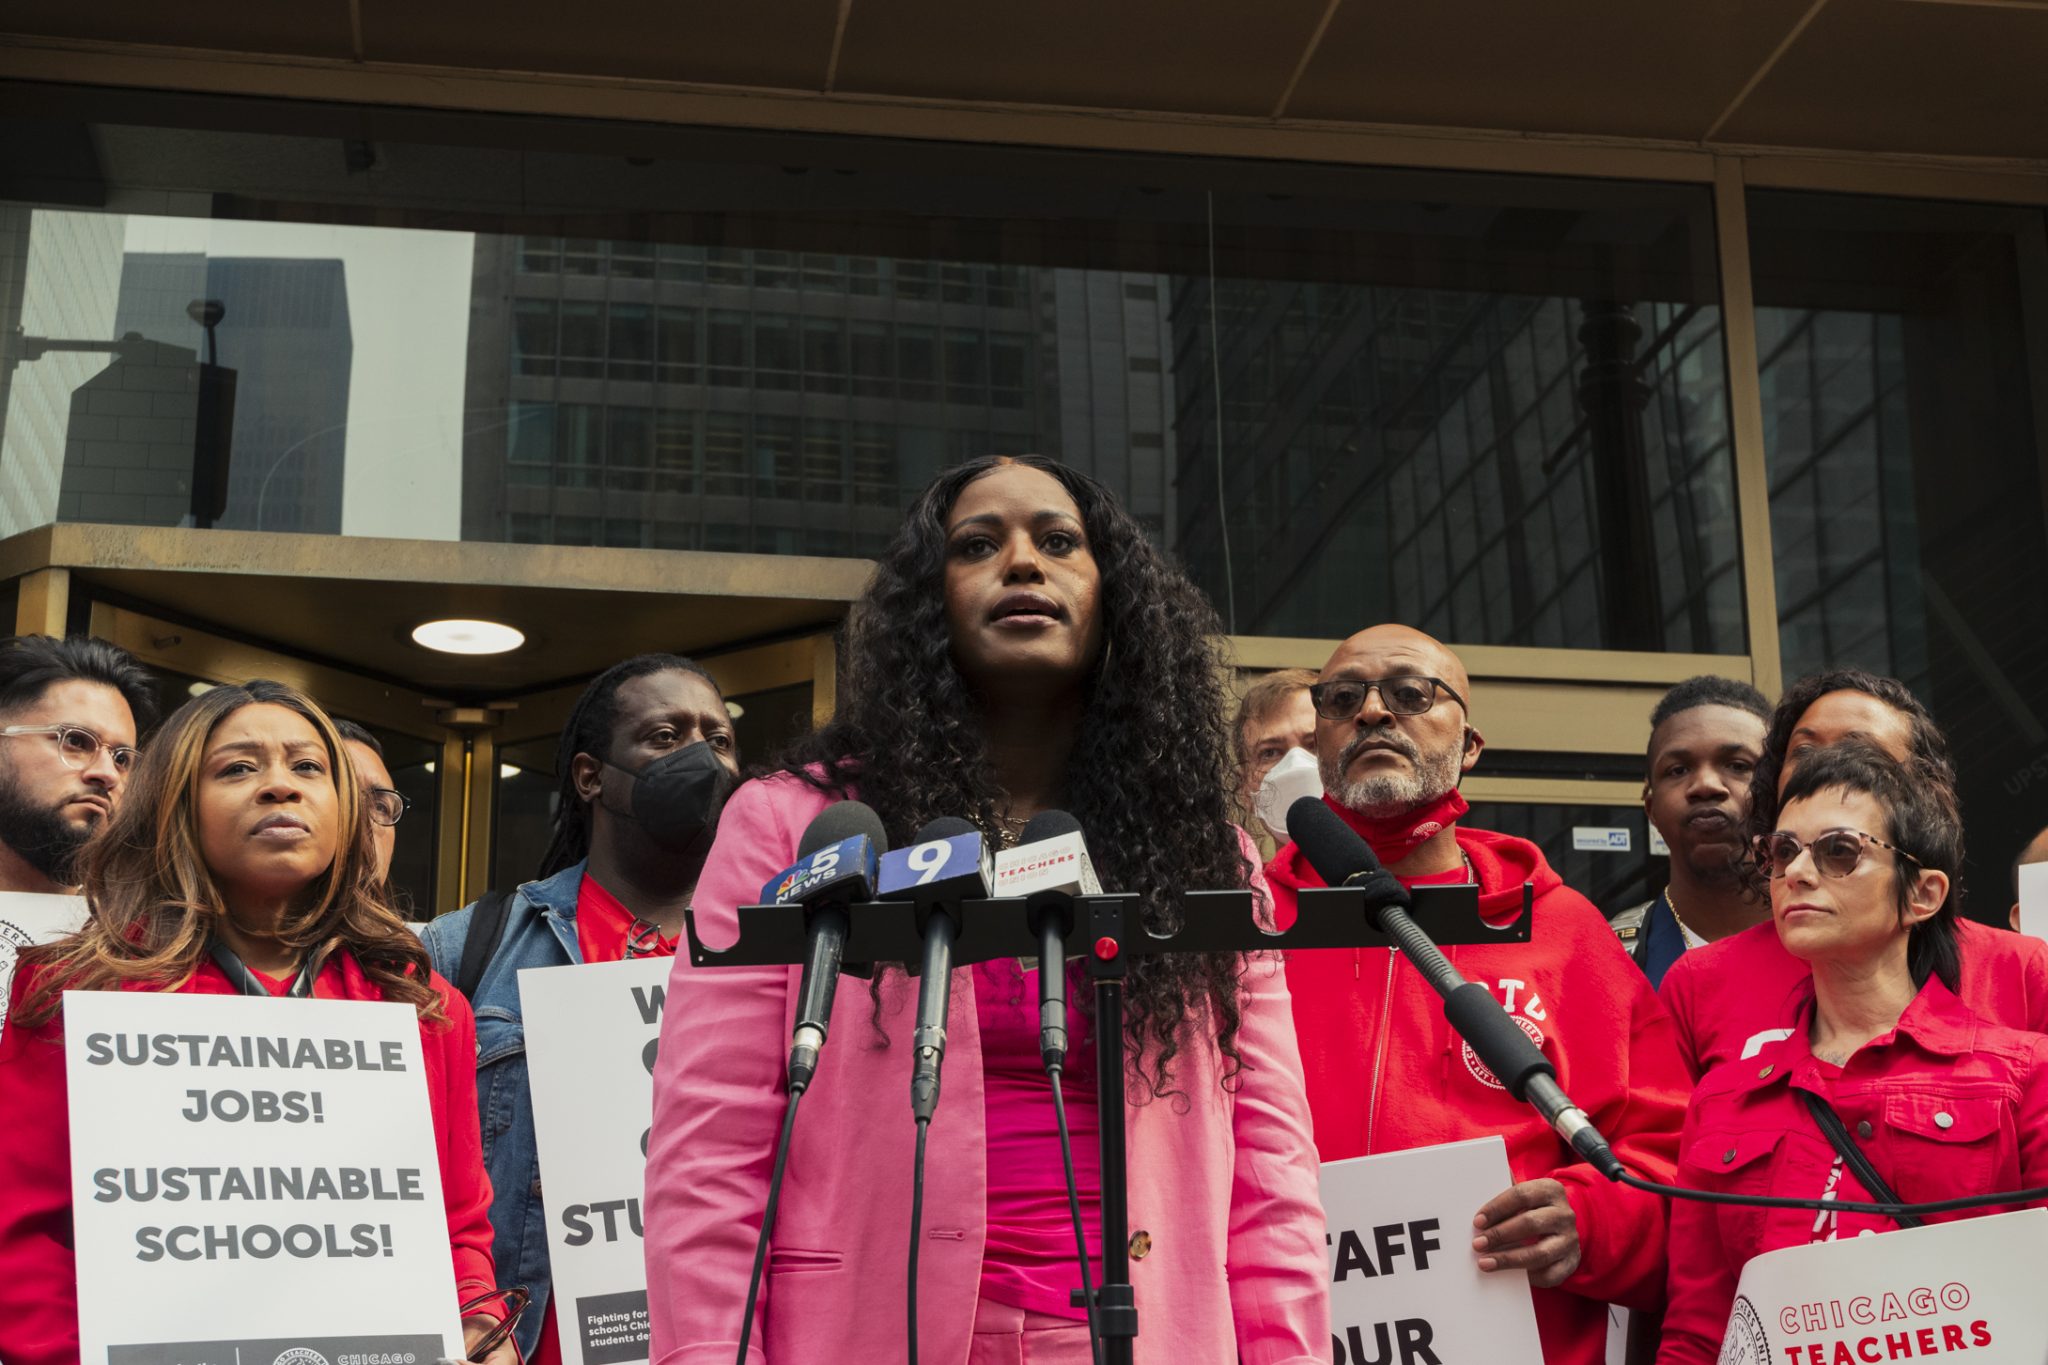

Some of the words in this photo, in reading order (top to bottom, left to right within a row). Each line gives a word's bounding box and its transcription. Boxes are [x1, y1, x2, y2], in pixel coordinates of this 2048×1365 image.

[810, 840, 840, 875] 5
[908, 839, 952, 886] 9
[1000, 853, 1075, 878] TEACHERS
[776, 867, 837, 905] NEWS
[86, 1032, 407, 1072] SUSTAINABLE
[1474, 1064, 1489, 1080] AFT
[182, 1089, 324, 1123] JOBS!
[93, 1166, 425, 1203] SUSTAINABLE
[135, 1223, 394, 1262] SCHOOLS!
[1326, 1217, 1441, 1283] AFF
[587, 1312, 631, 1325] Fighting
[632, 1310, 648, 1319] for
[1779, 1282, 1970, 1335] CHICAGO
[588, 1323, 628, 1336] schools
[590, 1334, 635, 1347] students
[636, 1332, 651, 1341] de
[1784, 1319, 1992, 1365] TEACHERS
[337, 1352, 416, 1365] CHICAGO
